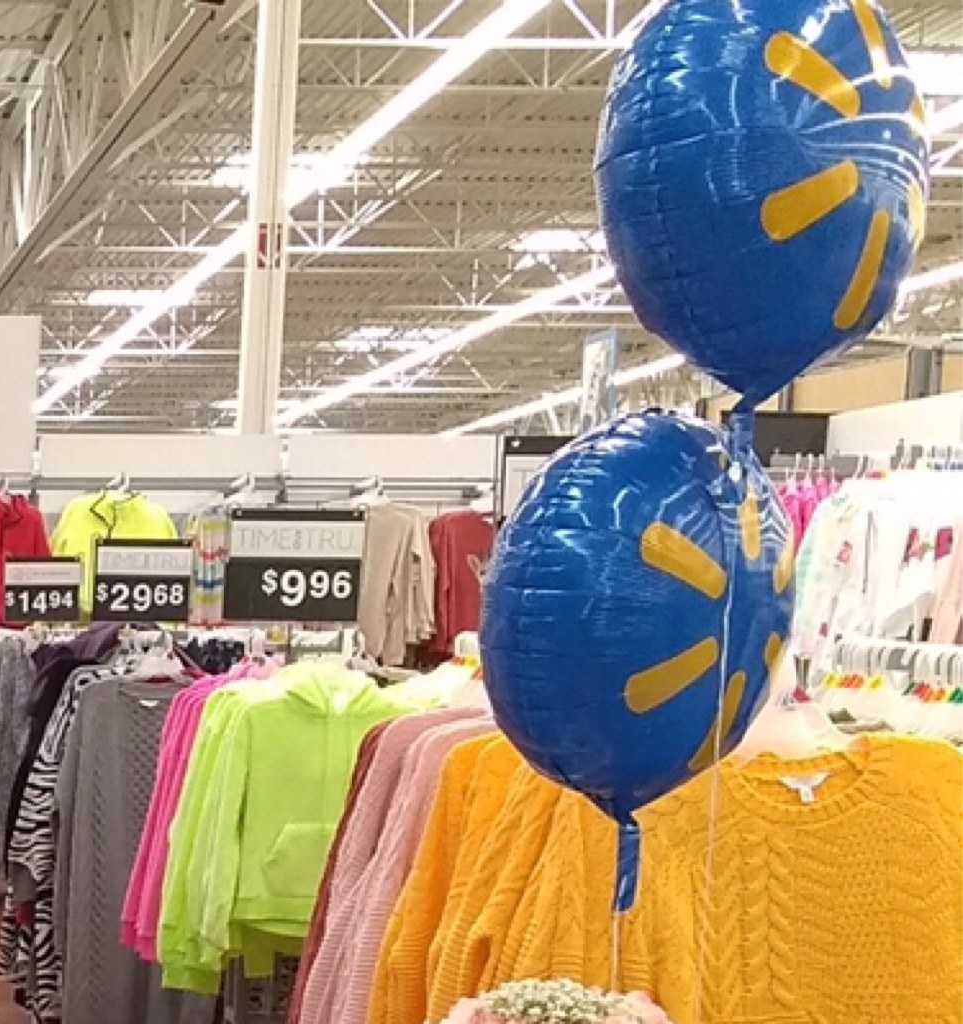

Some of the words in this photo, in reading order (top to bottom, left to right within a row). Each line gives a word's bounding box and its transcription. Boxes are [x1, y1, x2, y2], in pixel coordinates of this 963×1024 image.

[236, 527, 292, 550] TIME
[97, 581, 185, 613] $2968
[261, 566, 353, 607] $996
[5, 589, 74, 614] $1494
